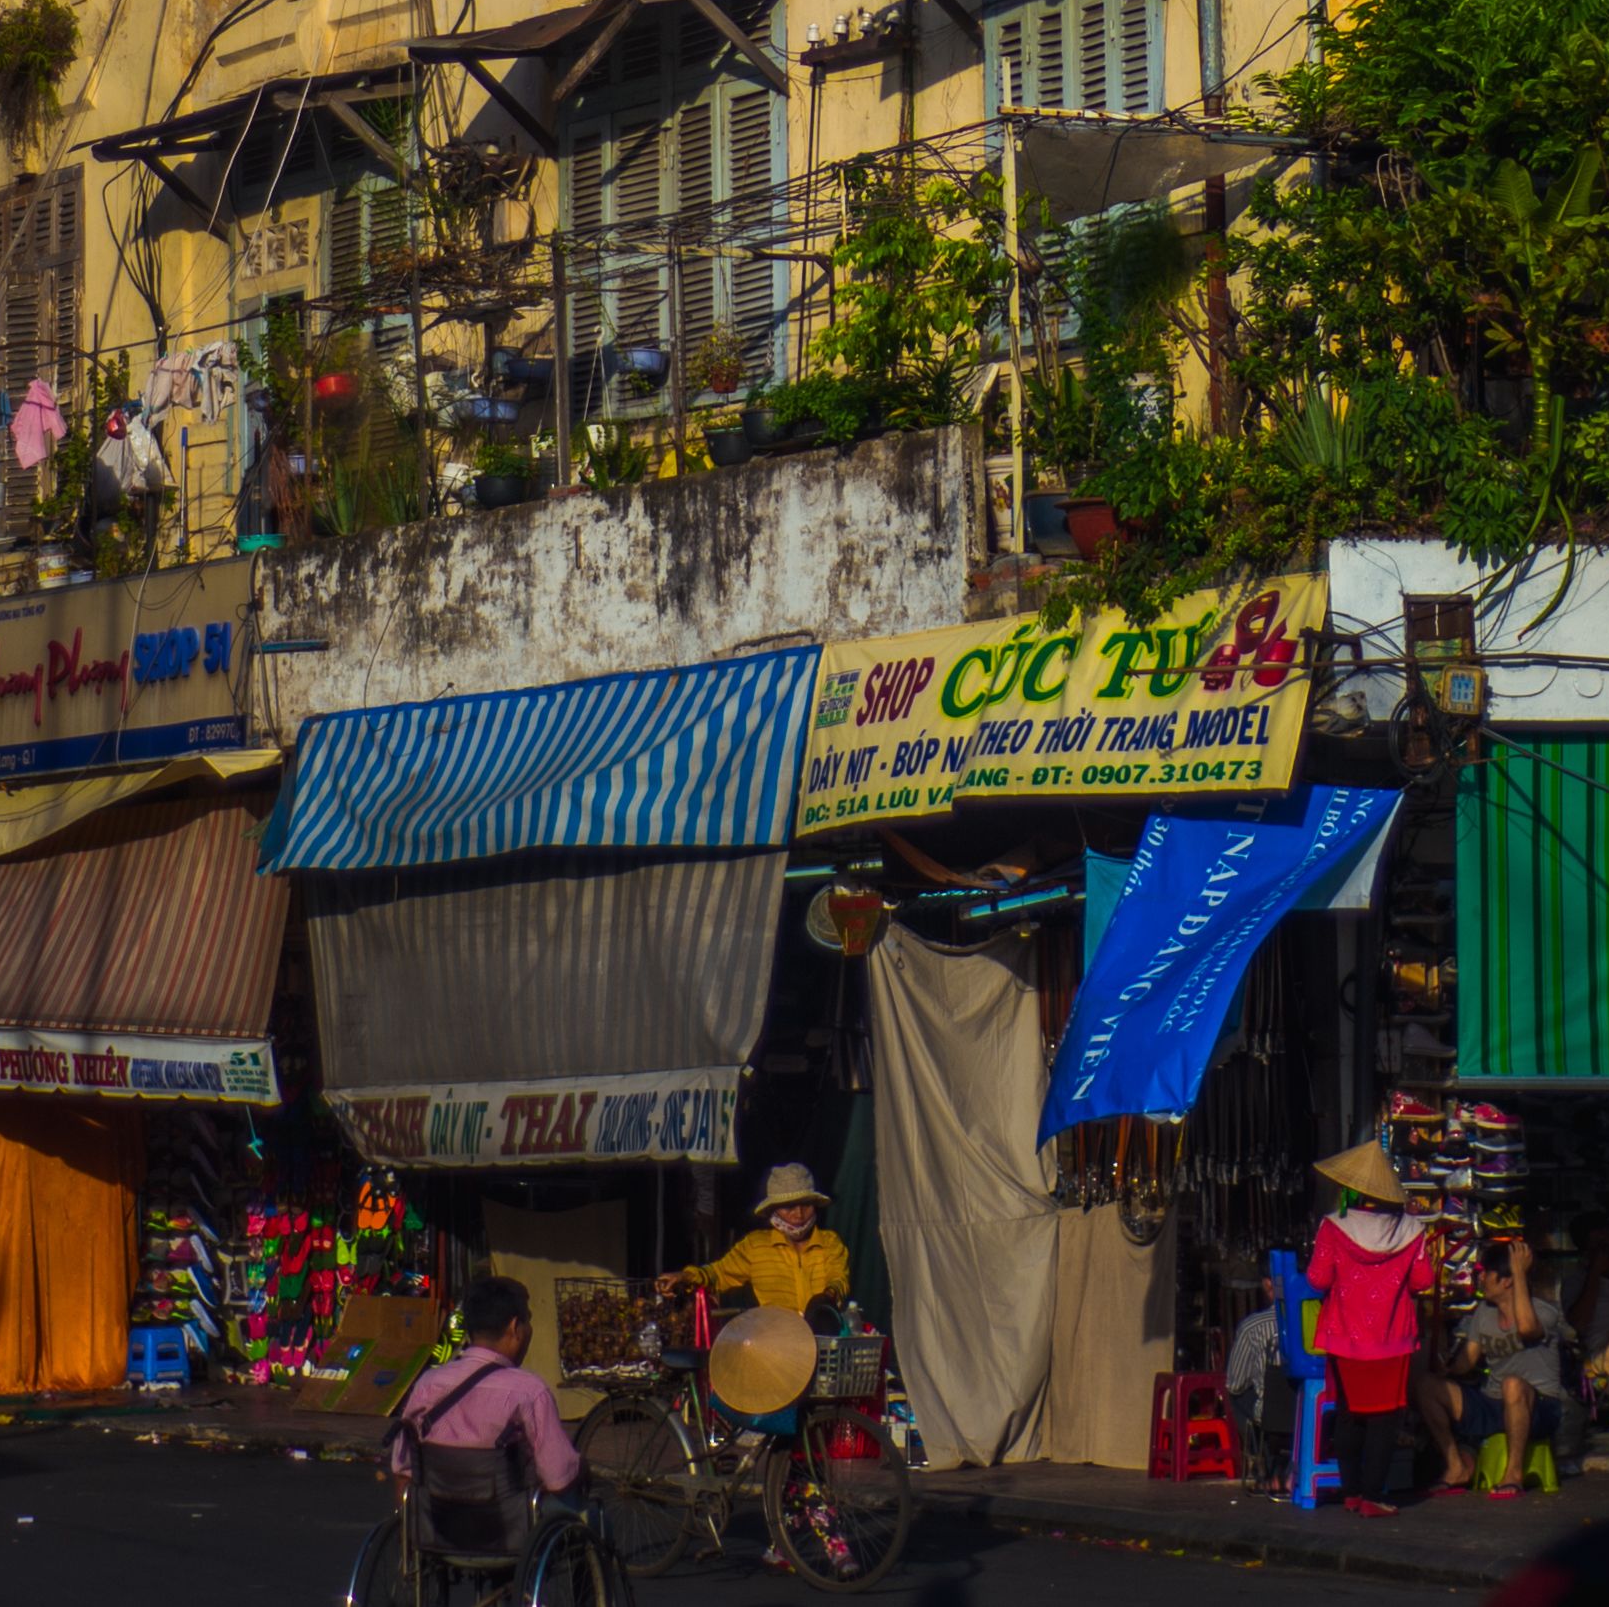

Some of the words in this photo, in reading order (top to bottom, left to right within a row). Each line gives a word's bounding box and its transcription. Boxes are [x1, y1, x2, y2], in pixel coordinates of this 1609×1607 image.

[134, 624, 200, 684] SHOP
[204, 621, 232, 674] 51
[856, 657, 935, 727] SHOP
[941, 621, 1080, 719] CÚC
[808, 745, 844, 794] DÂY
[844, 745, 879, 792] NỊT
[891, 729, 940, 778] BÓP
[972, 720, 1034, 756] THEO
[1096, 713, 1177, 753] TRANG
[1188, 706, 1270, 748] MODEL
[805, 805, 831, 826] ĐC:
[836, 795, 869, 817] 51A
[876, 786, 920, 810] LƯU
[1032, 765, 1073, 787] ĐT:
[1082, 759, 1263, 784] 0907.310473
[1195, 827, 1258, 909] NẠP
[72, 1045, 130, 1088] NHIÊN
[229, 1052, 261, 1067] 51
[500, 1091, 598, 1156] THAI
[660, 1089, 690, 1151] ONE
[687, 1089, 718, 1151] DAY
